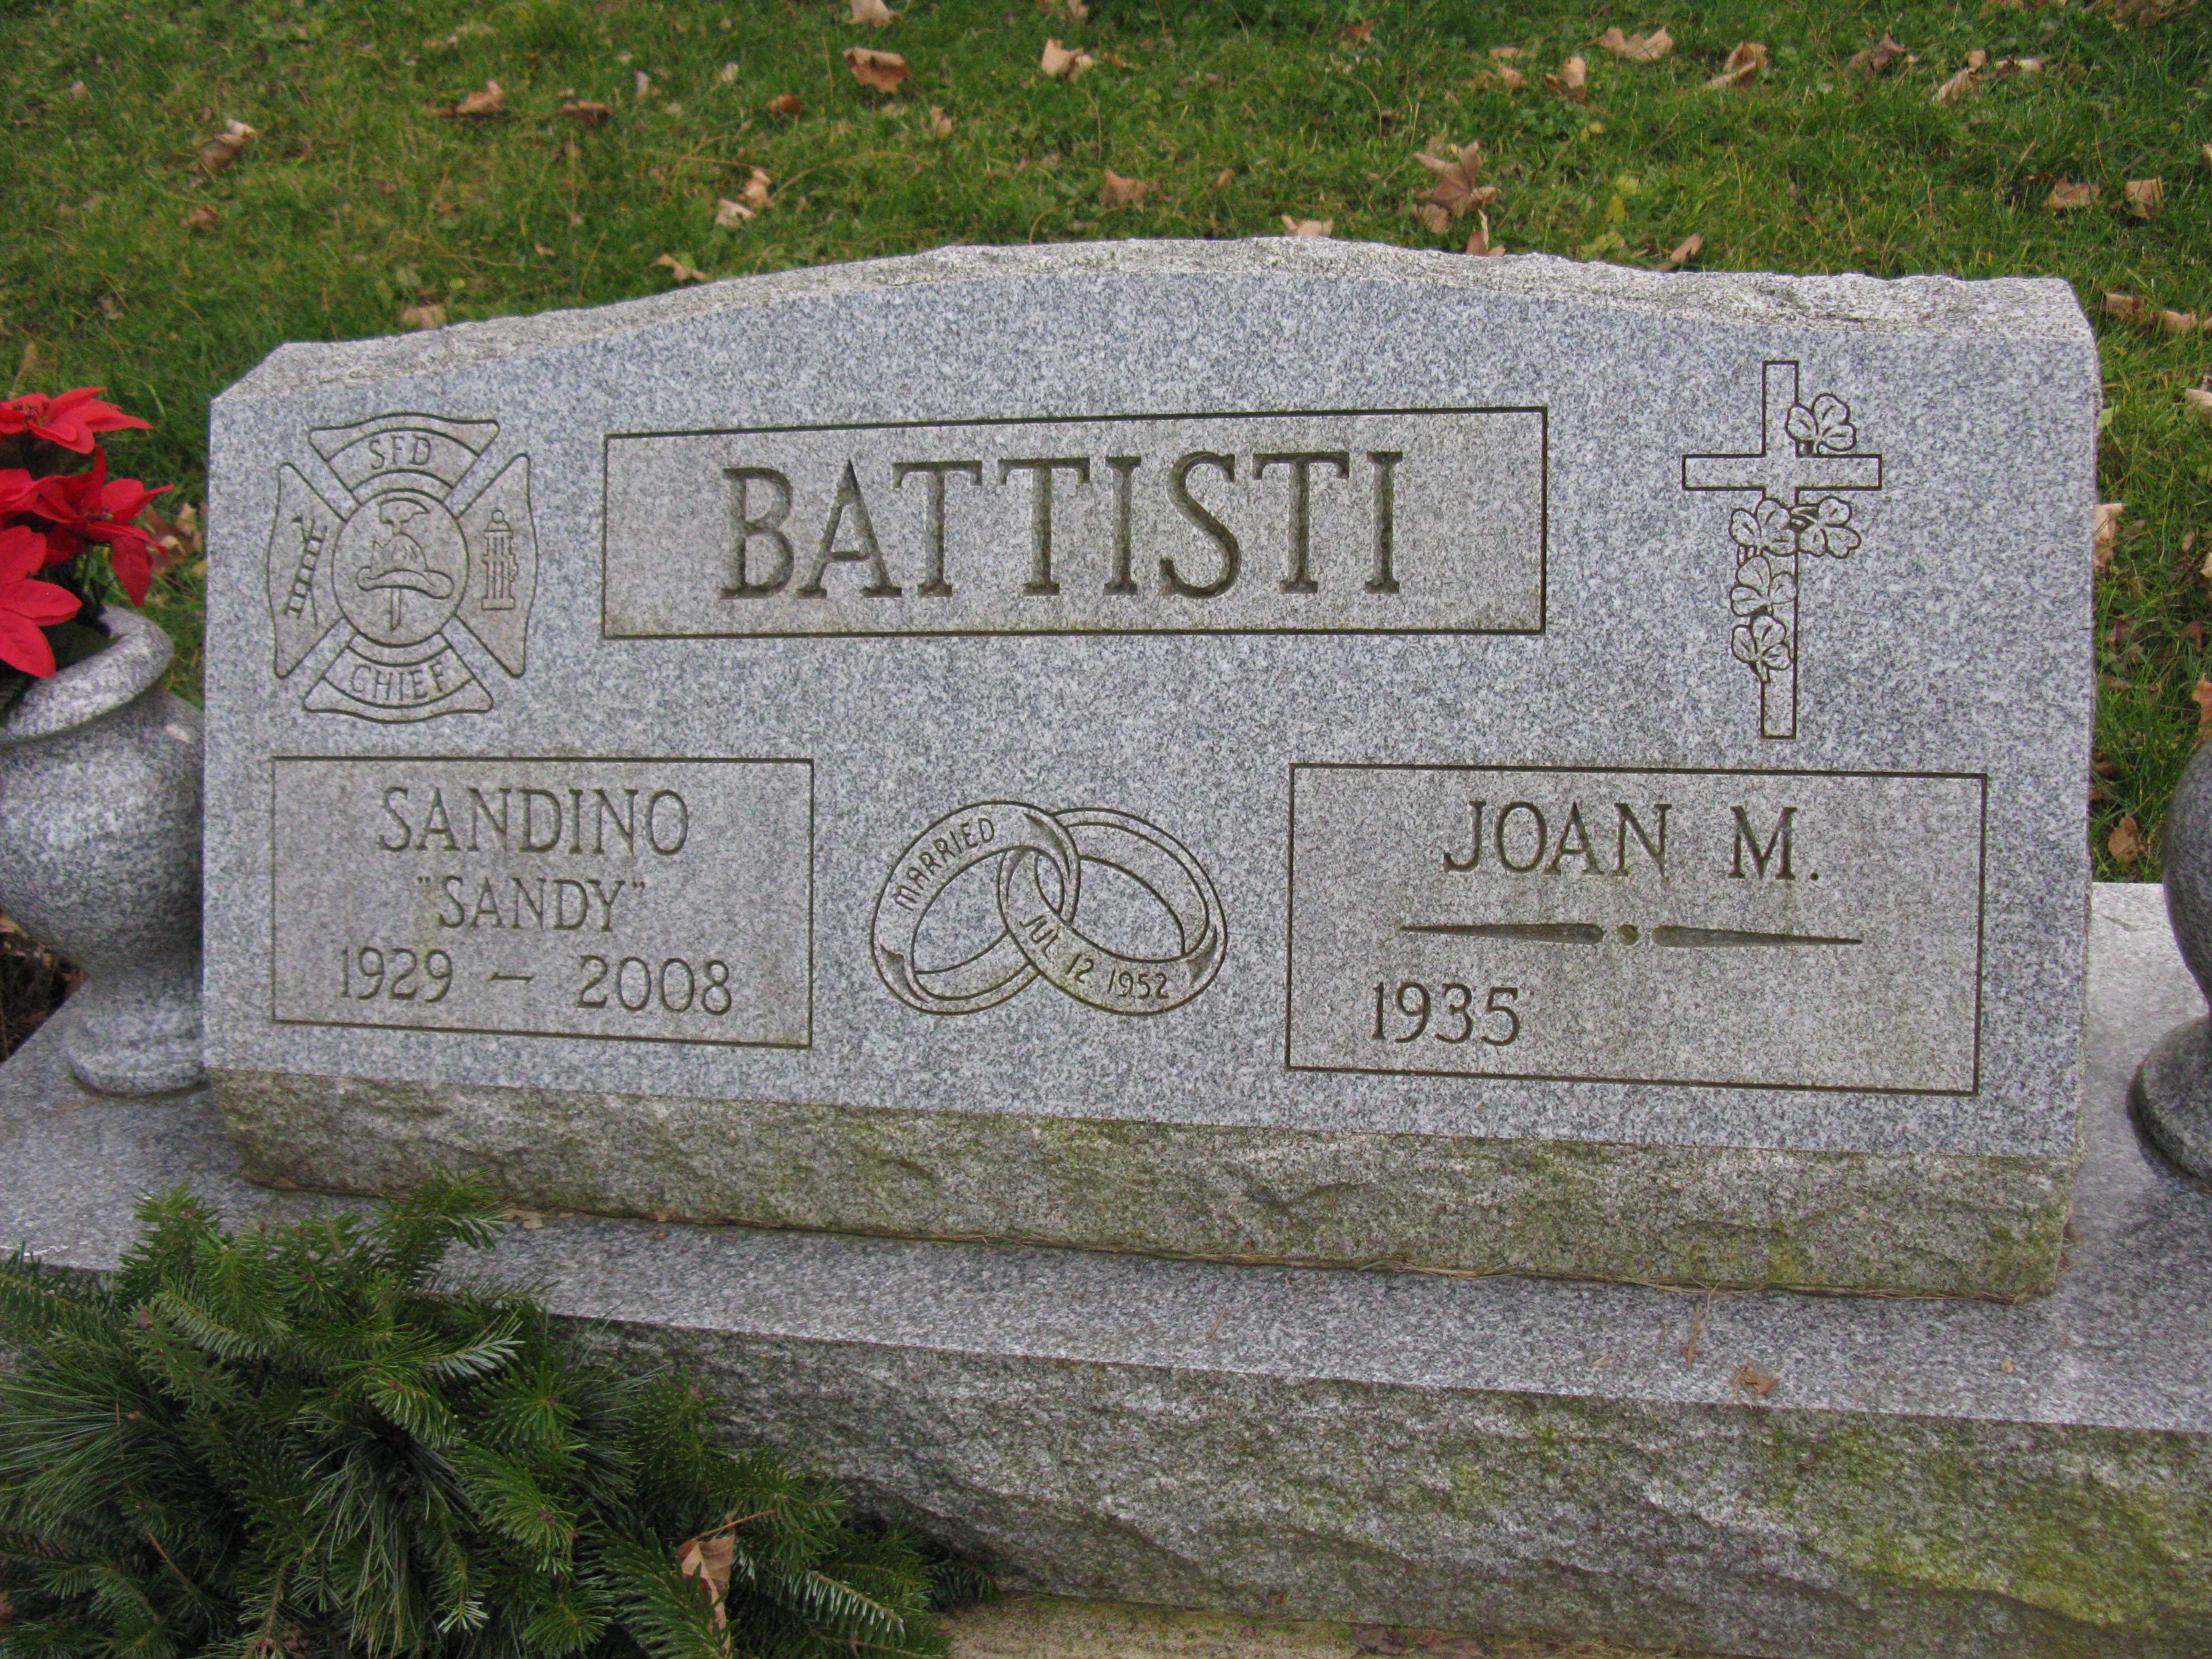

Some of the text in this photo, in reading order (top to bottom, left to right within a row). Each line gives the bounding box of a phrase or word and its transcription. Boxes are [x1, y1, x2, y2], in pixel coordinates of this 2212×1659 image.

[369, 434, 431, 470] SFD
[719, 450, 1403, 601] BATTISTI
[351, 662, 446, 701] CHIEF
[378, 786, 689, 857] SANDINO
[1443, 800, 1821, 881] JOAN M.
[892, 818, 995, 912] MARRIED
[418, 875, 646, 933] "SANDY"
[340, 946, 453, 1004] 1929
[577, 954, 732, 1016] 2008
[1019, 914, 1169, 1000] JUL 12 1952
[1371, 981, 1521, 1046] 1935
